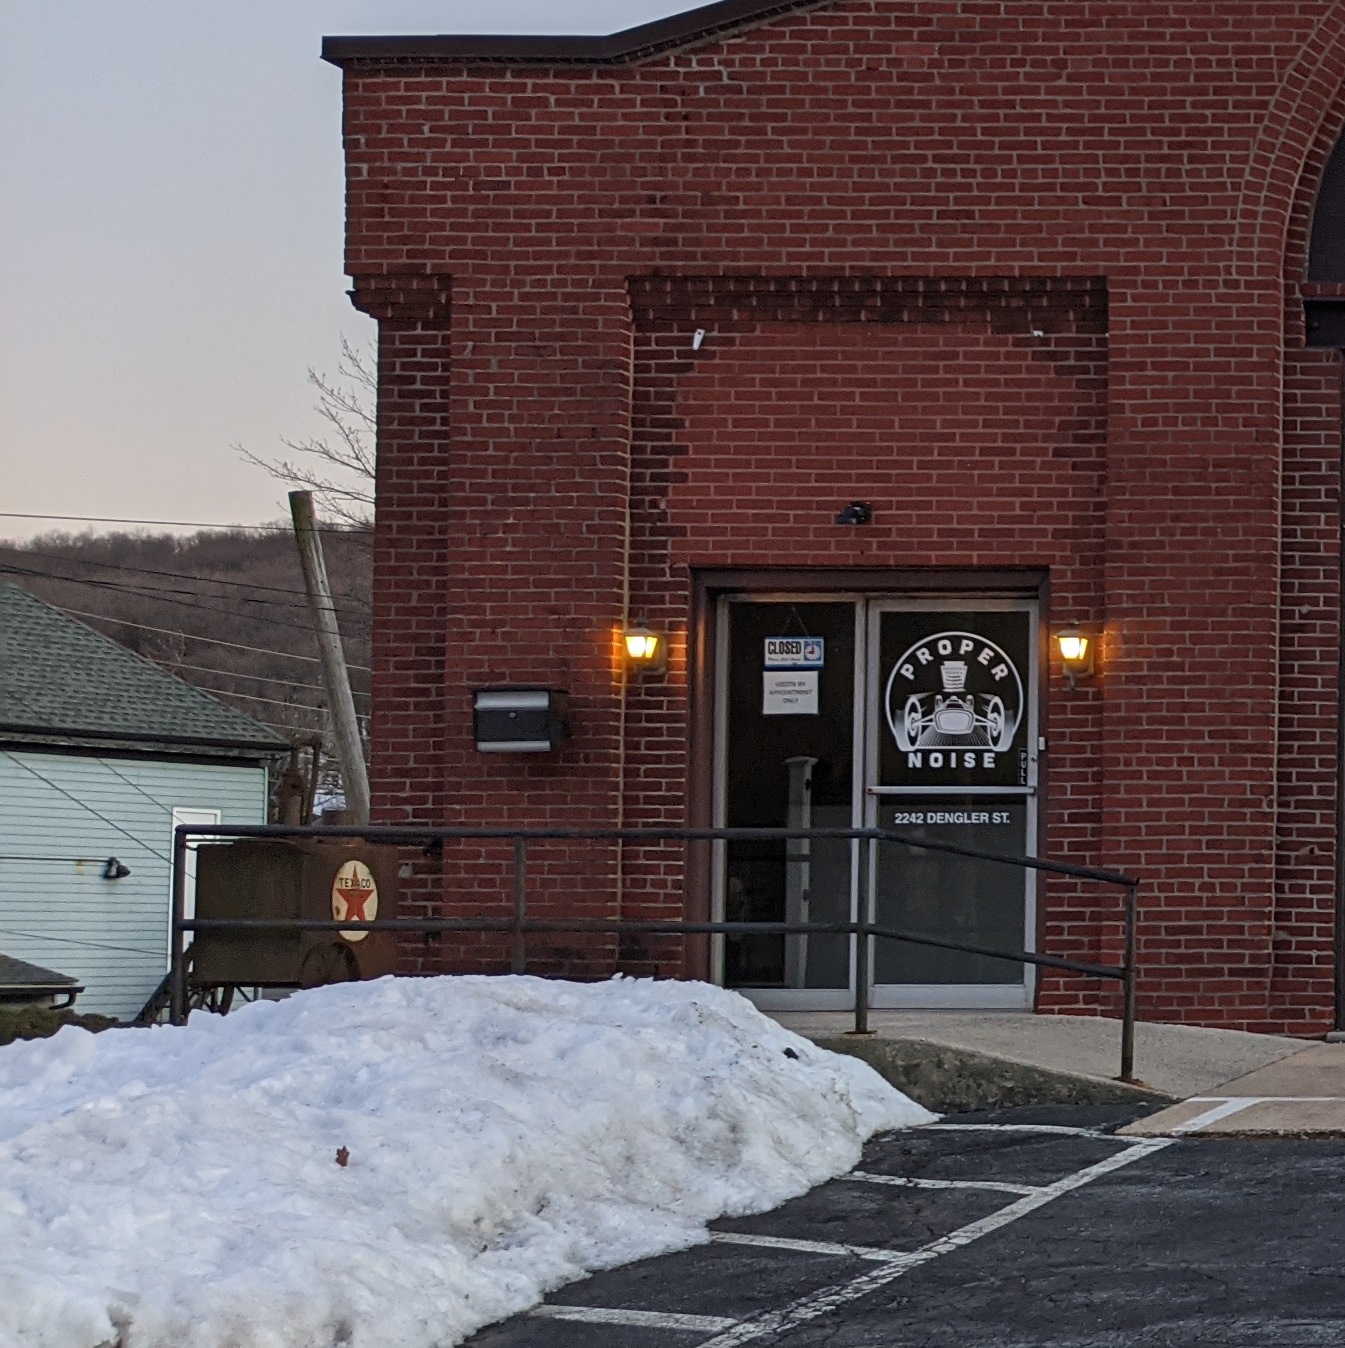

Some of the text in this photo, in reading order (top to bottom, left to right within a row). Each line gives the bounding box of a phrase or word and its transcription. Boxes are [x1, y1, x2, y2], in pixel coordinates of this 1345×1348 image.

[767, 640, 802, 655] CLOSED
[900, 639, 1009, 681] PROPER
[907, 752, 996, 768] NOISE
[894, 812, 1011, 824] 2242 DENGLER ST.
[339, 878, 371, 888] TEXACO
